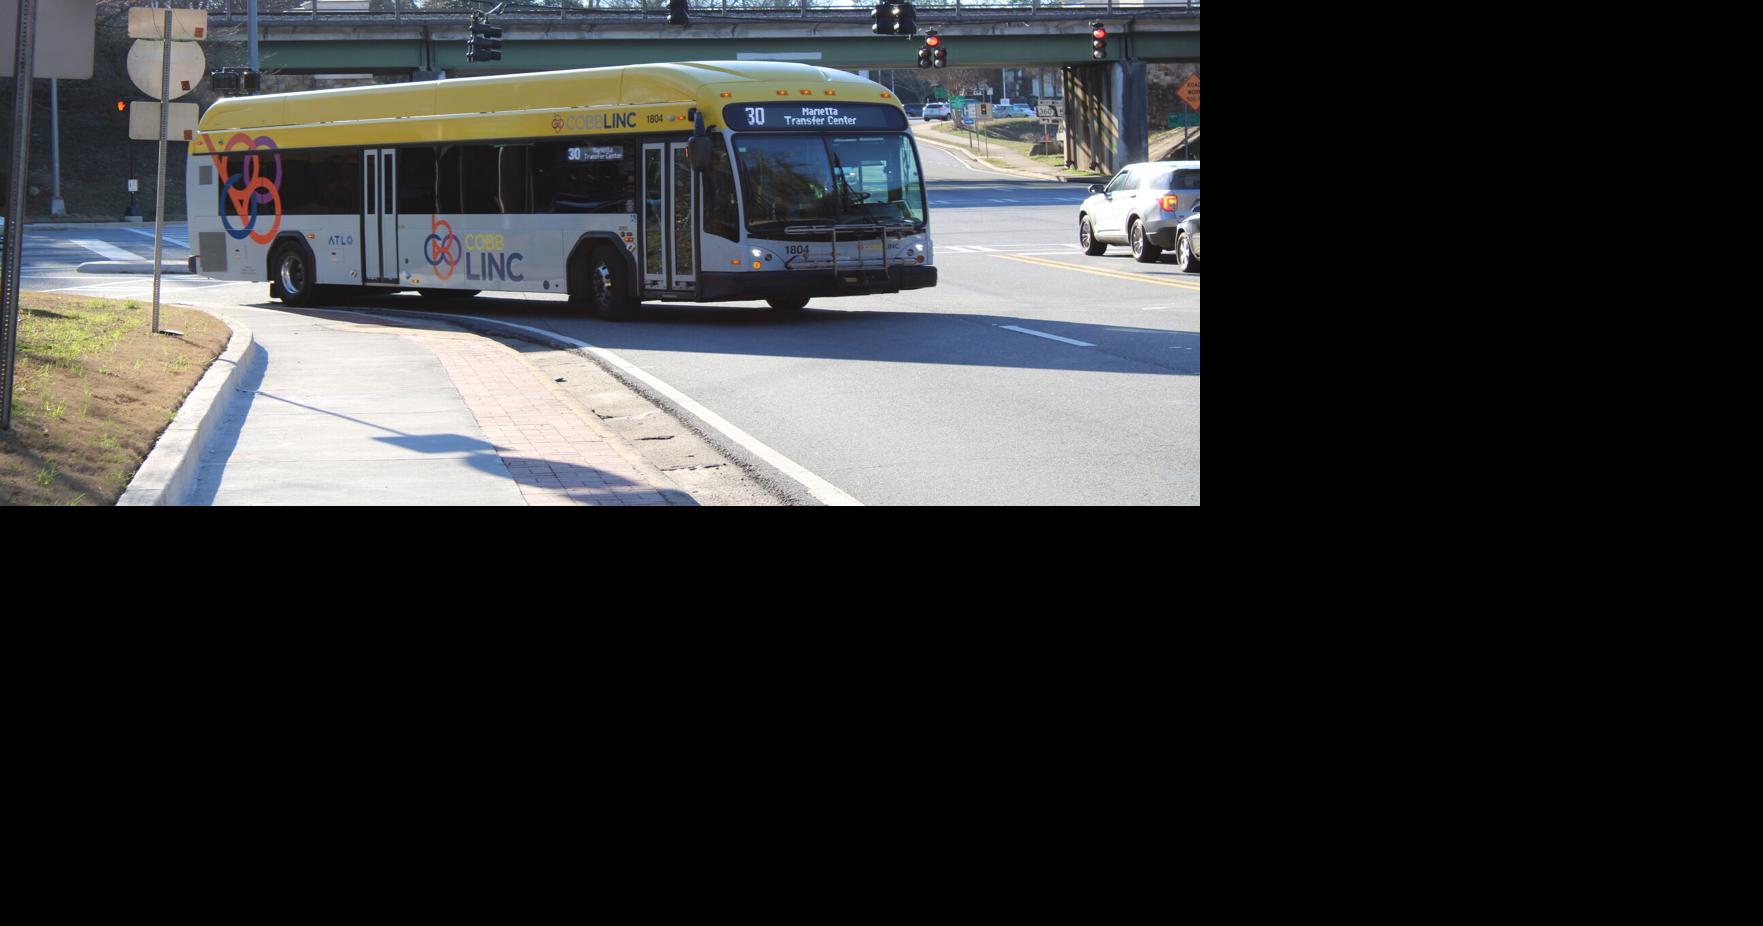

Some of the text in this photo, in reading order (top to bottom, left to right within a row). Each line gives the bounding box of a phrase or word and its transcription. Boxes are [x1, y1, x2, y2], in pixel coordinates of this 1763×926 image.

[745, 107, 765, 125] 30
[802, 107, 838, 116] Marietta
[646, 114, 663, 123] 1804
[784, 115, 856, 125] Transfer Center
[567, 147, 581, 160] 30
[464, 233, 505, 250] COBB
[784, 244, 809, 256] 1804
[465, 252, 524, 282] LINC
